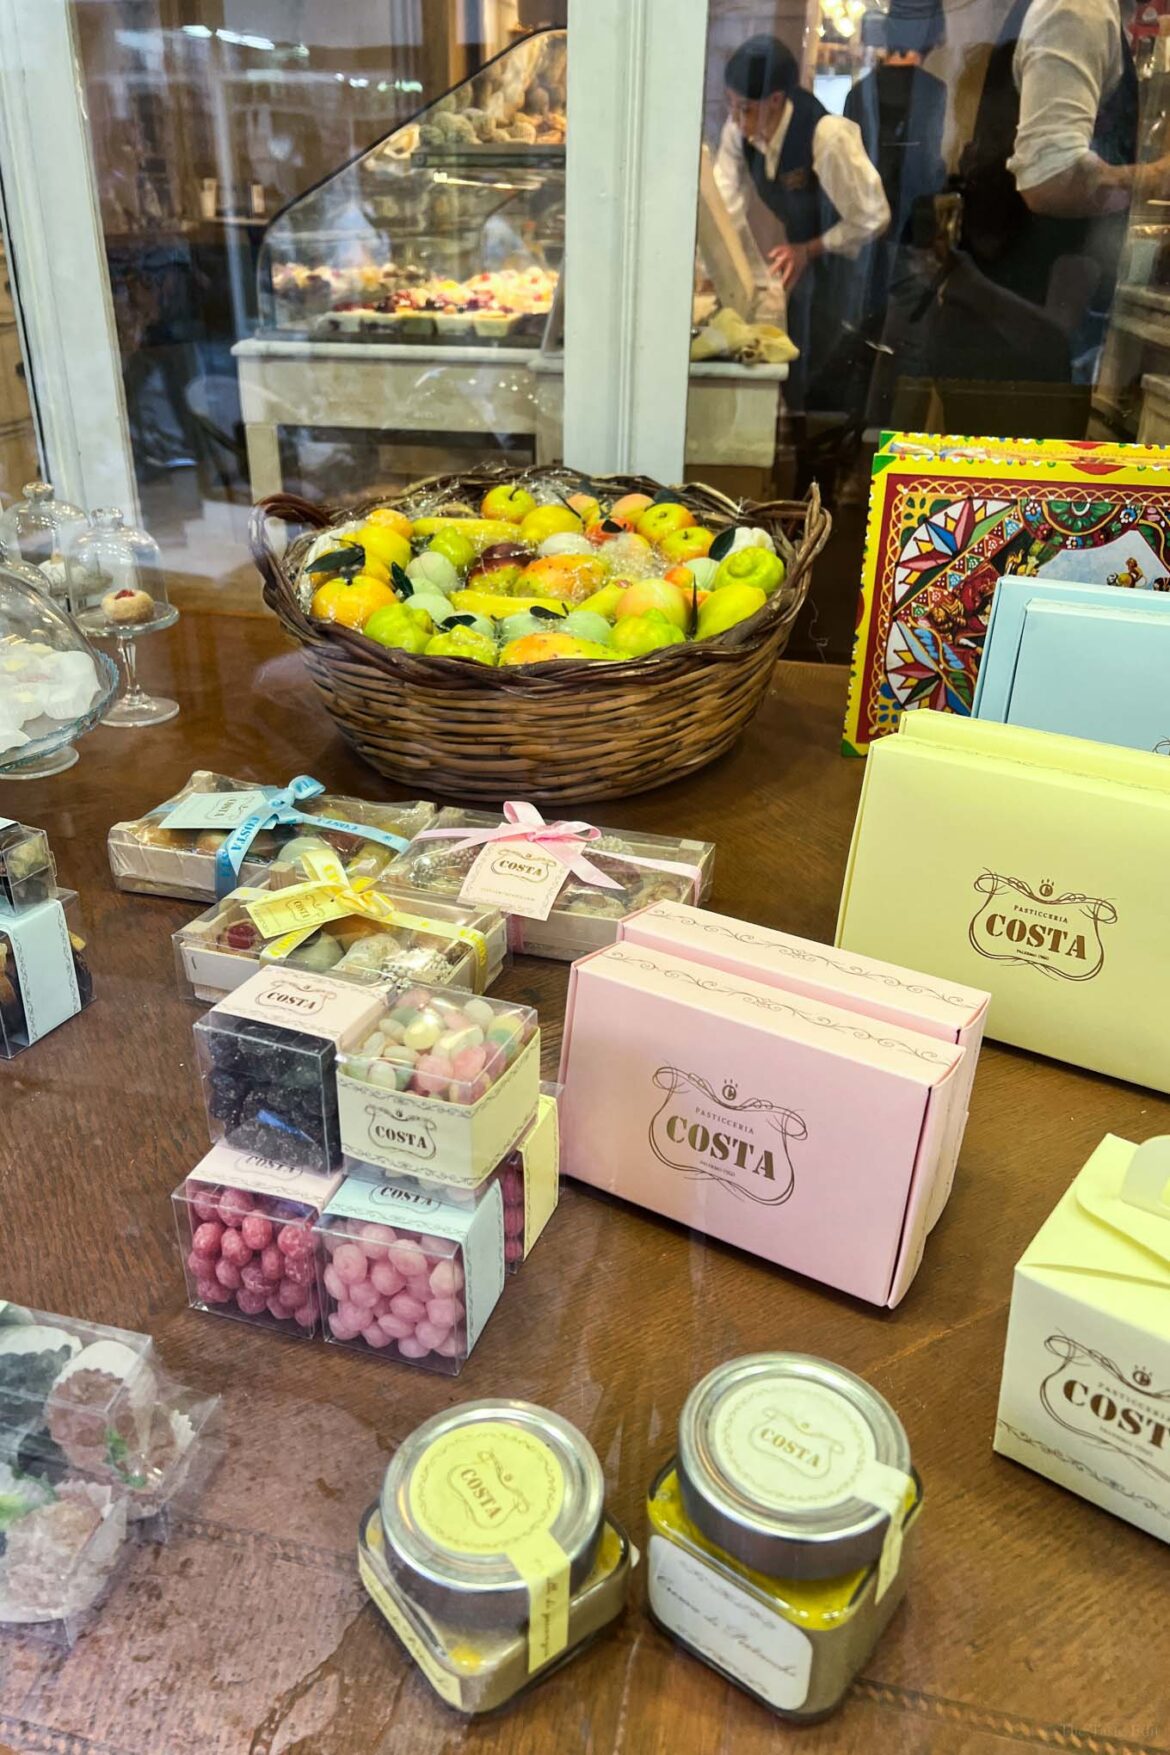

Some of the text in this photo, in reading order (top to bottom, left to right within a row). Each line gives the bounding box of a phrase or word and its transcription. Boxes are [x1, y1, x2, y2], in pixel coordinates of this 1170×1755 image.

[231, 815, 260, 851] COSTA
[499, 859, 544, 877] COSTA
[1013, 904, 1069, 924] PASTICCERIA
[985, 912, 1087, 960] COSTA
[266, 990, 317, 1011] COSTA
[695, 1106, 755, 1135] PASTICCERIA
[374, 1122, 428, 1151] COSTA
[666, 1115, 776, 1181] COSTA
[380, 1186, 434, 1207] COSTA
[760, 1427, 821, 1469] COSTA
[460, 1468, 504, 1520] COSTA
